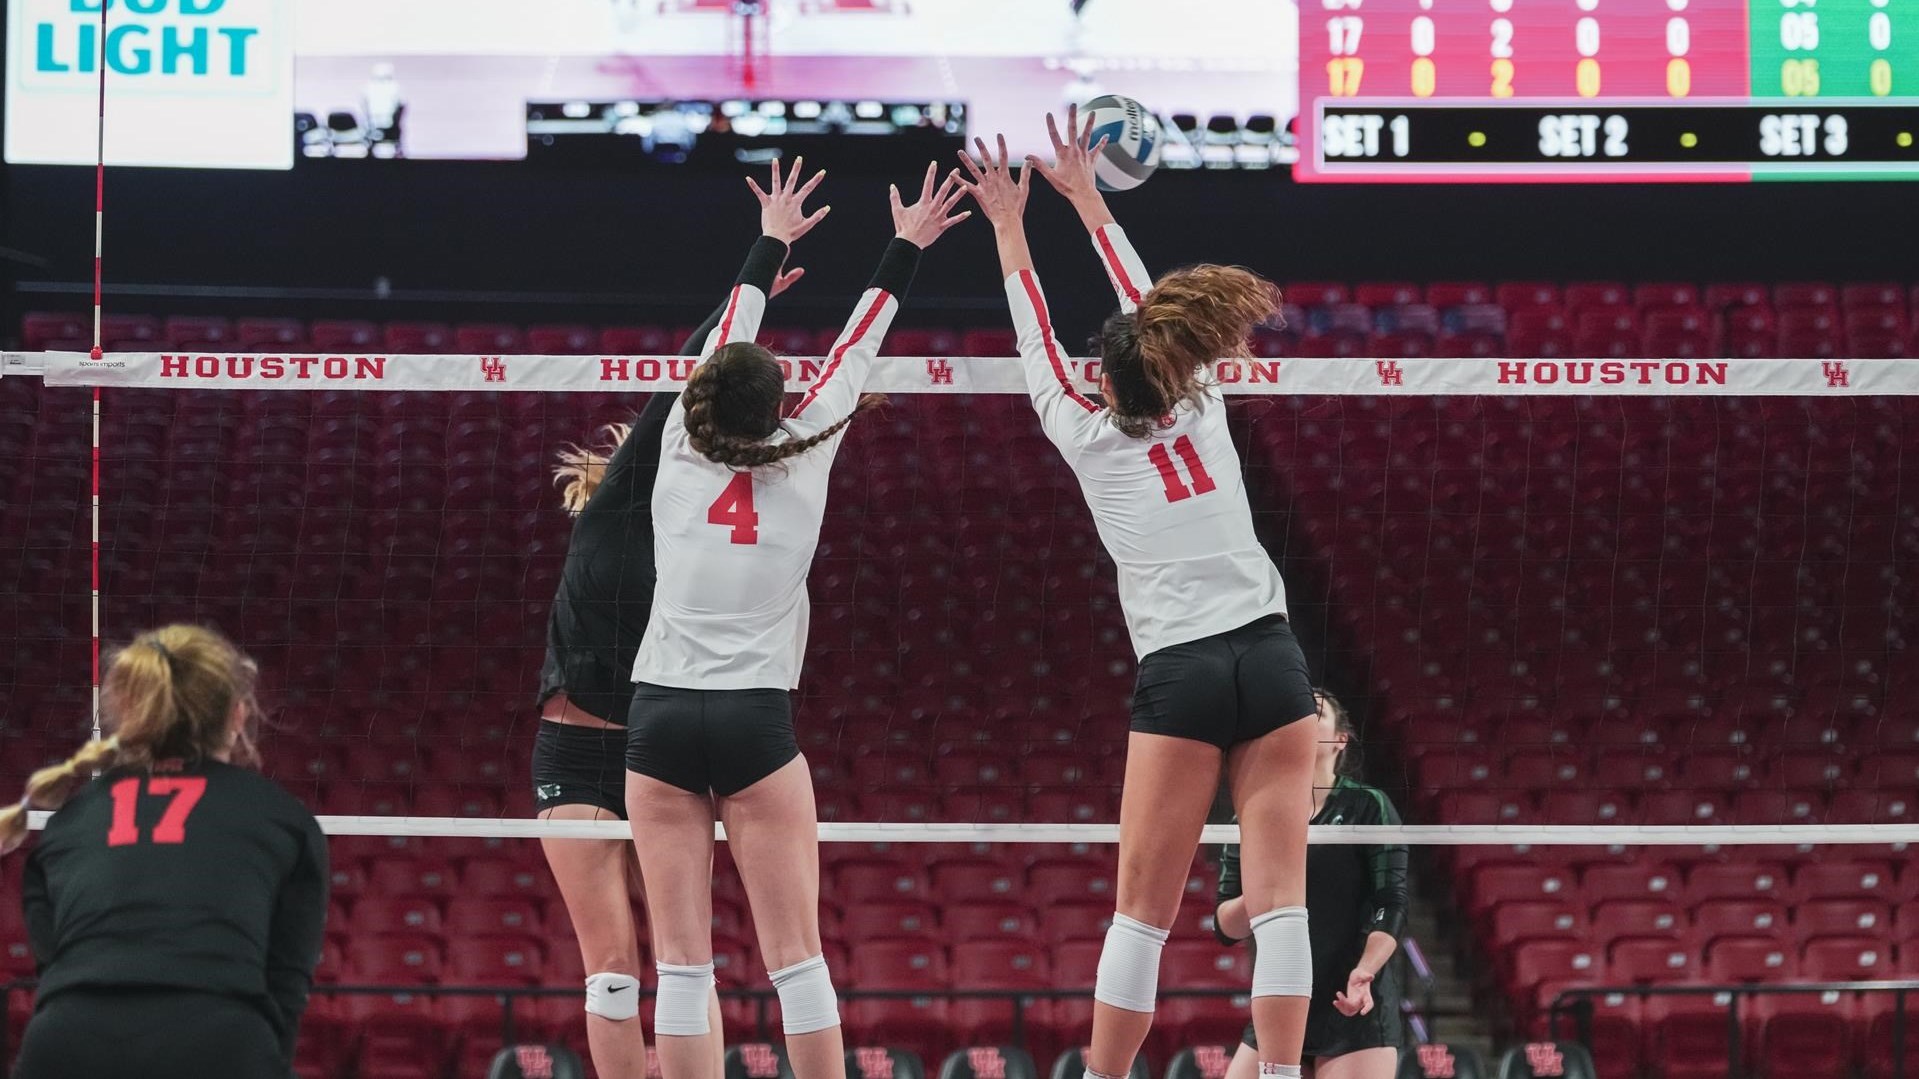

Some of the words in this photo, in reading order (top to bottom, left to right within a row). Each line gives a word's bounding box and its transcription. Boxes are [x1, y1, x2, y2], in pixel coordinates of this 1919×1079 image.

[36, 23, 258, 76] LIGHT
[1326, 16, 1363, 55] 17
[1411, 16, 1435, 56] 0
[1490, 18, 1514, 58] 2
[1576, 17, 1600, 57] 0
[1666, 17, 1690, 57] 0
[1780, 12, 1820, 51] 05
[1869, 12, 1891, 51] 0
[1326, 57, 1364, 97] 17
[1411, 57, 1436, 97] 0
[1490, 58, 1515, 98] 2
[1576, 58, 1601, 98] 0
[1666, 58, 1691, 98] 0
[1781, 58, 1821, 97] 05
[1870, 58, 1892, 97] 0
[1324, 114, 1384, 157] SET
[1390, 114, 1410, 157] 1
[1538, 114, 1601, 157] SET
[1604, 114, 1629, 157] 2
[1759, 114, 1821, 156] SET
[1823, 114, 1848, 156] 3
[160, 355, 386, 379] HOUSTON
[1498, 362, 1728, 384] HOUSTON
[1147, 434, 1216, 503] 11
[708, 472, 758, 545] 4
[107, 777, 208, 847] 17
